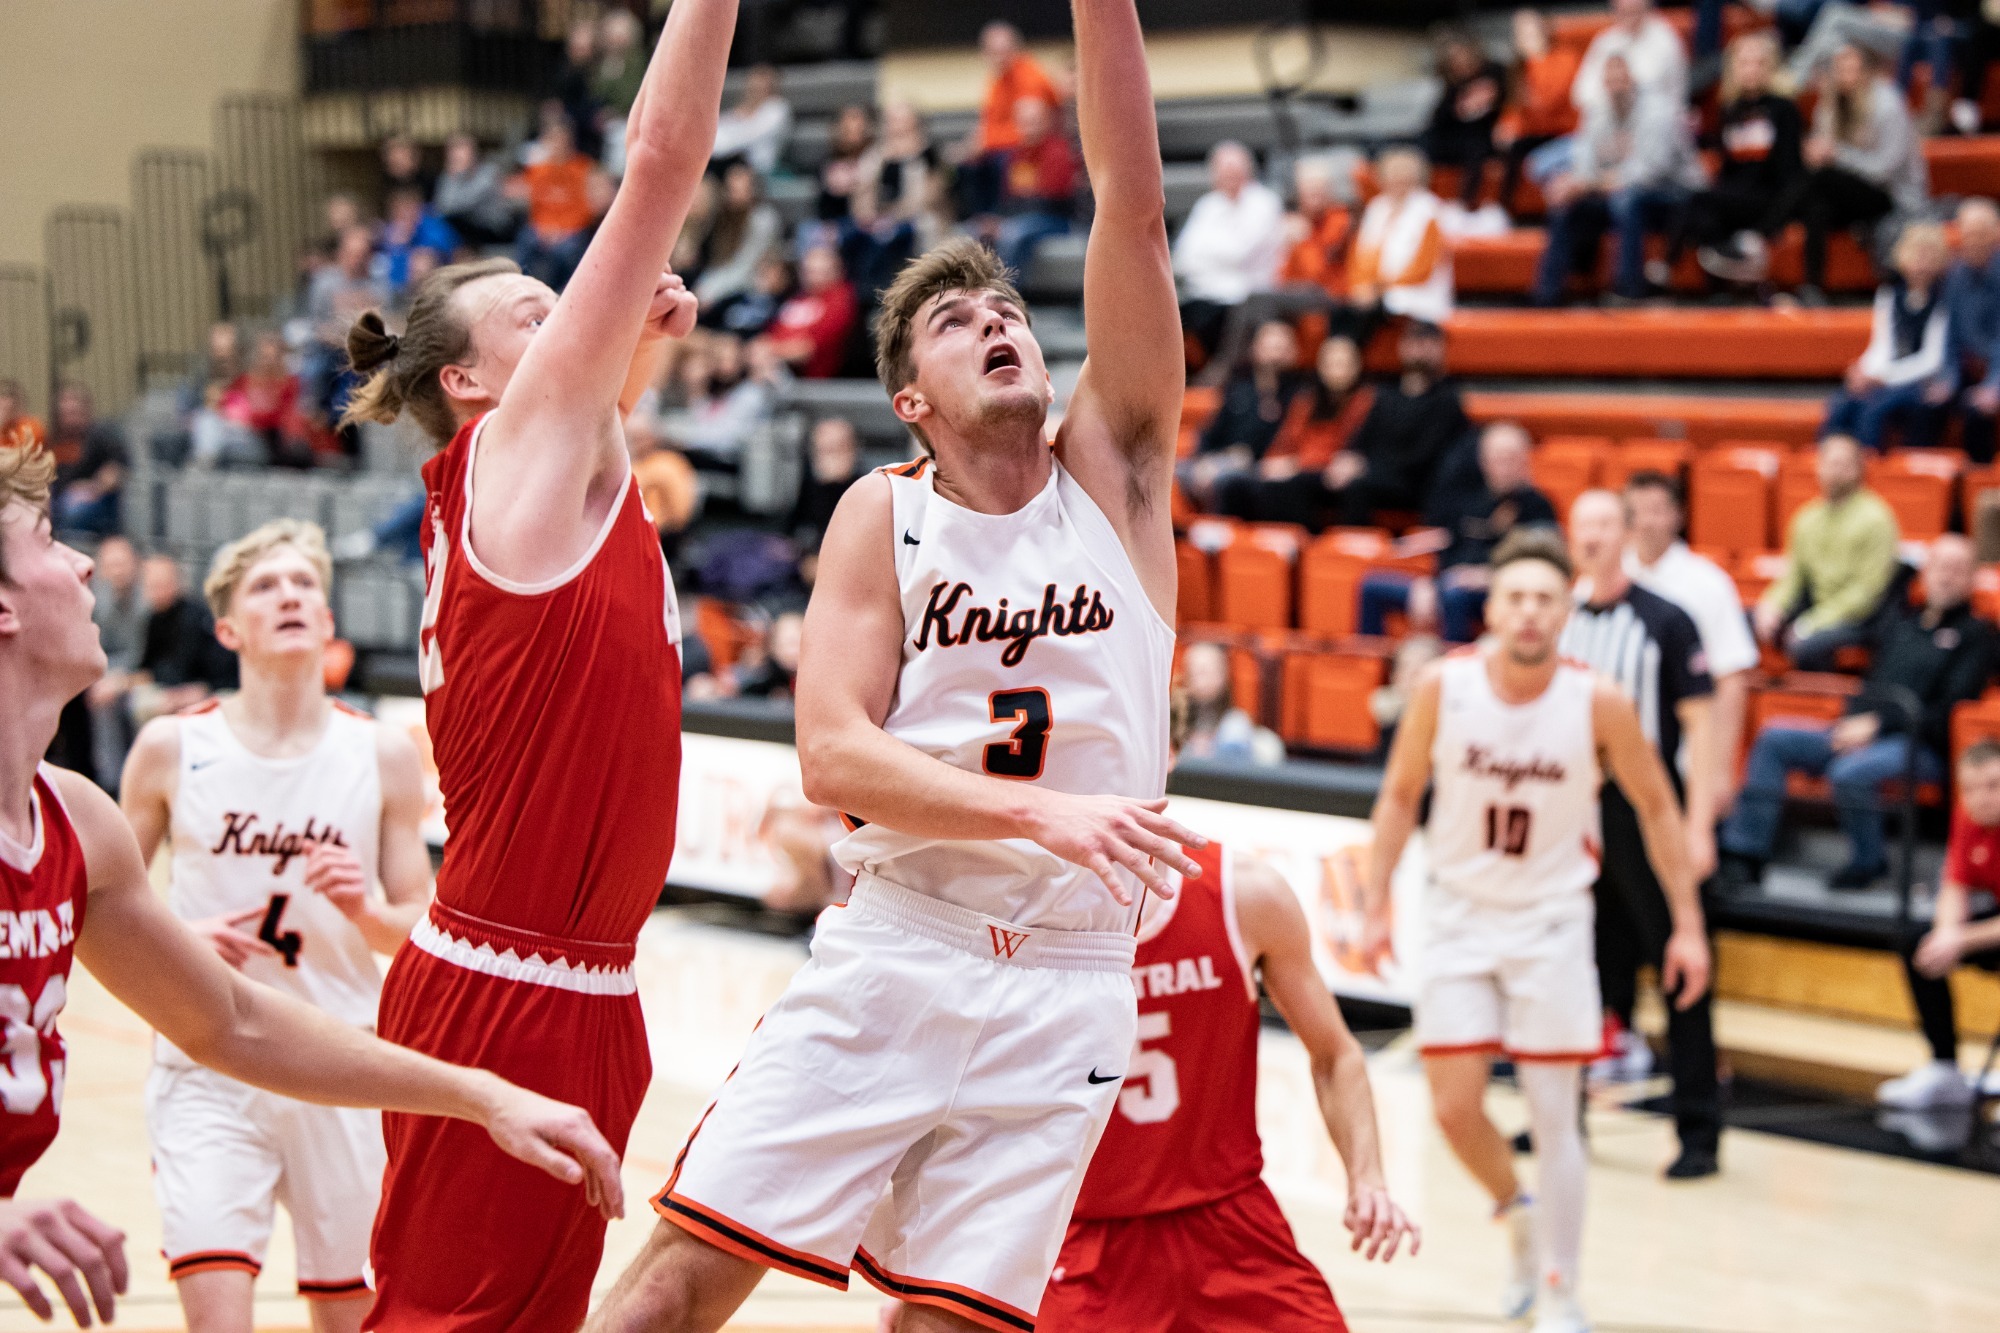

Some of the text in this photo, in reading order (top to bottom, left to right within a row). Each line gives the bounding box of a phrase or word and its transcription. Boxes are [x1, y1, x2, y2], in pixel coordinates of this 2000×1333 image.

[913, 580, 1114, 668] Knights
[982, 686, 1053, 781] 3
[259, 894, 302, 967] 4
[988, 924, 1031, 959] W
[1131, 955, 1222, 1000] TRAL
[1118, 1011, 1180, 1125] 5
